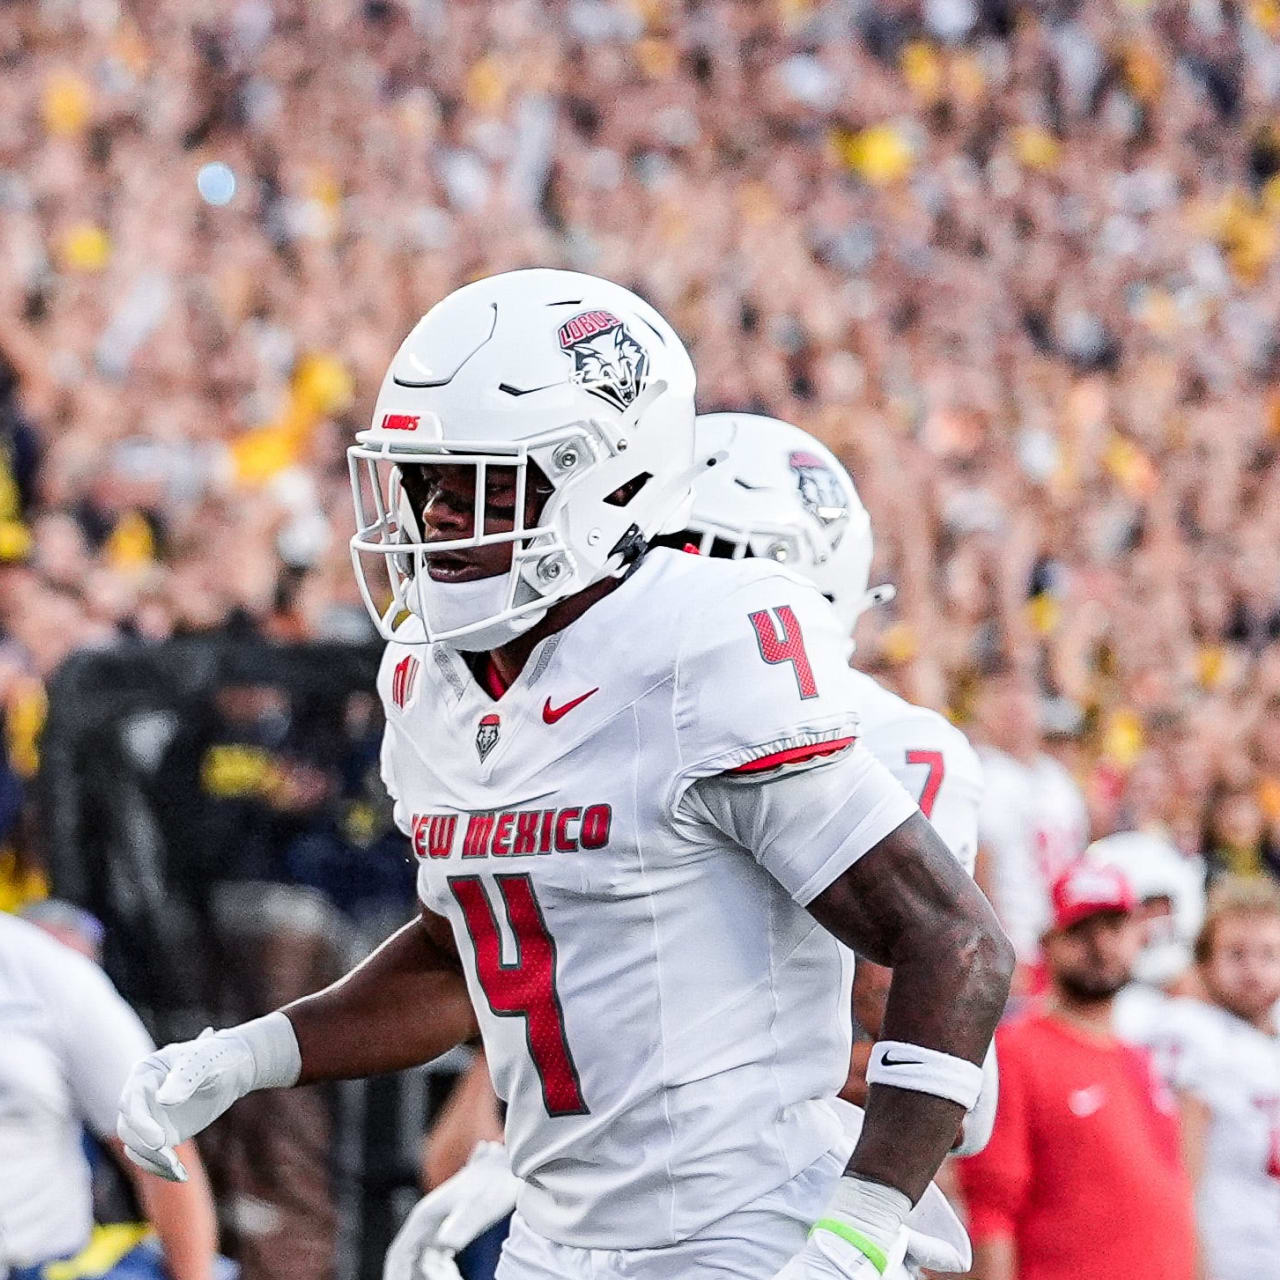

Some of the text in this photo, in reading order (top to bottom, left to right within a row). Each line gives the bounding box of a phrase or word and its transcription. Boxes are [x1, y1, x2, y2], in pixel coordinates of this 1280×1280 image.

[558, 310, 622, 348] LOBOS
[748, 604, 820, 700] 4
[904, 749, 945, 820] 7
[461, 803, 612, 859] MEXICO
[446, 871, 592, 1119] 4
